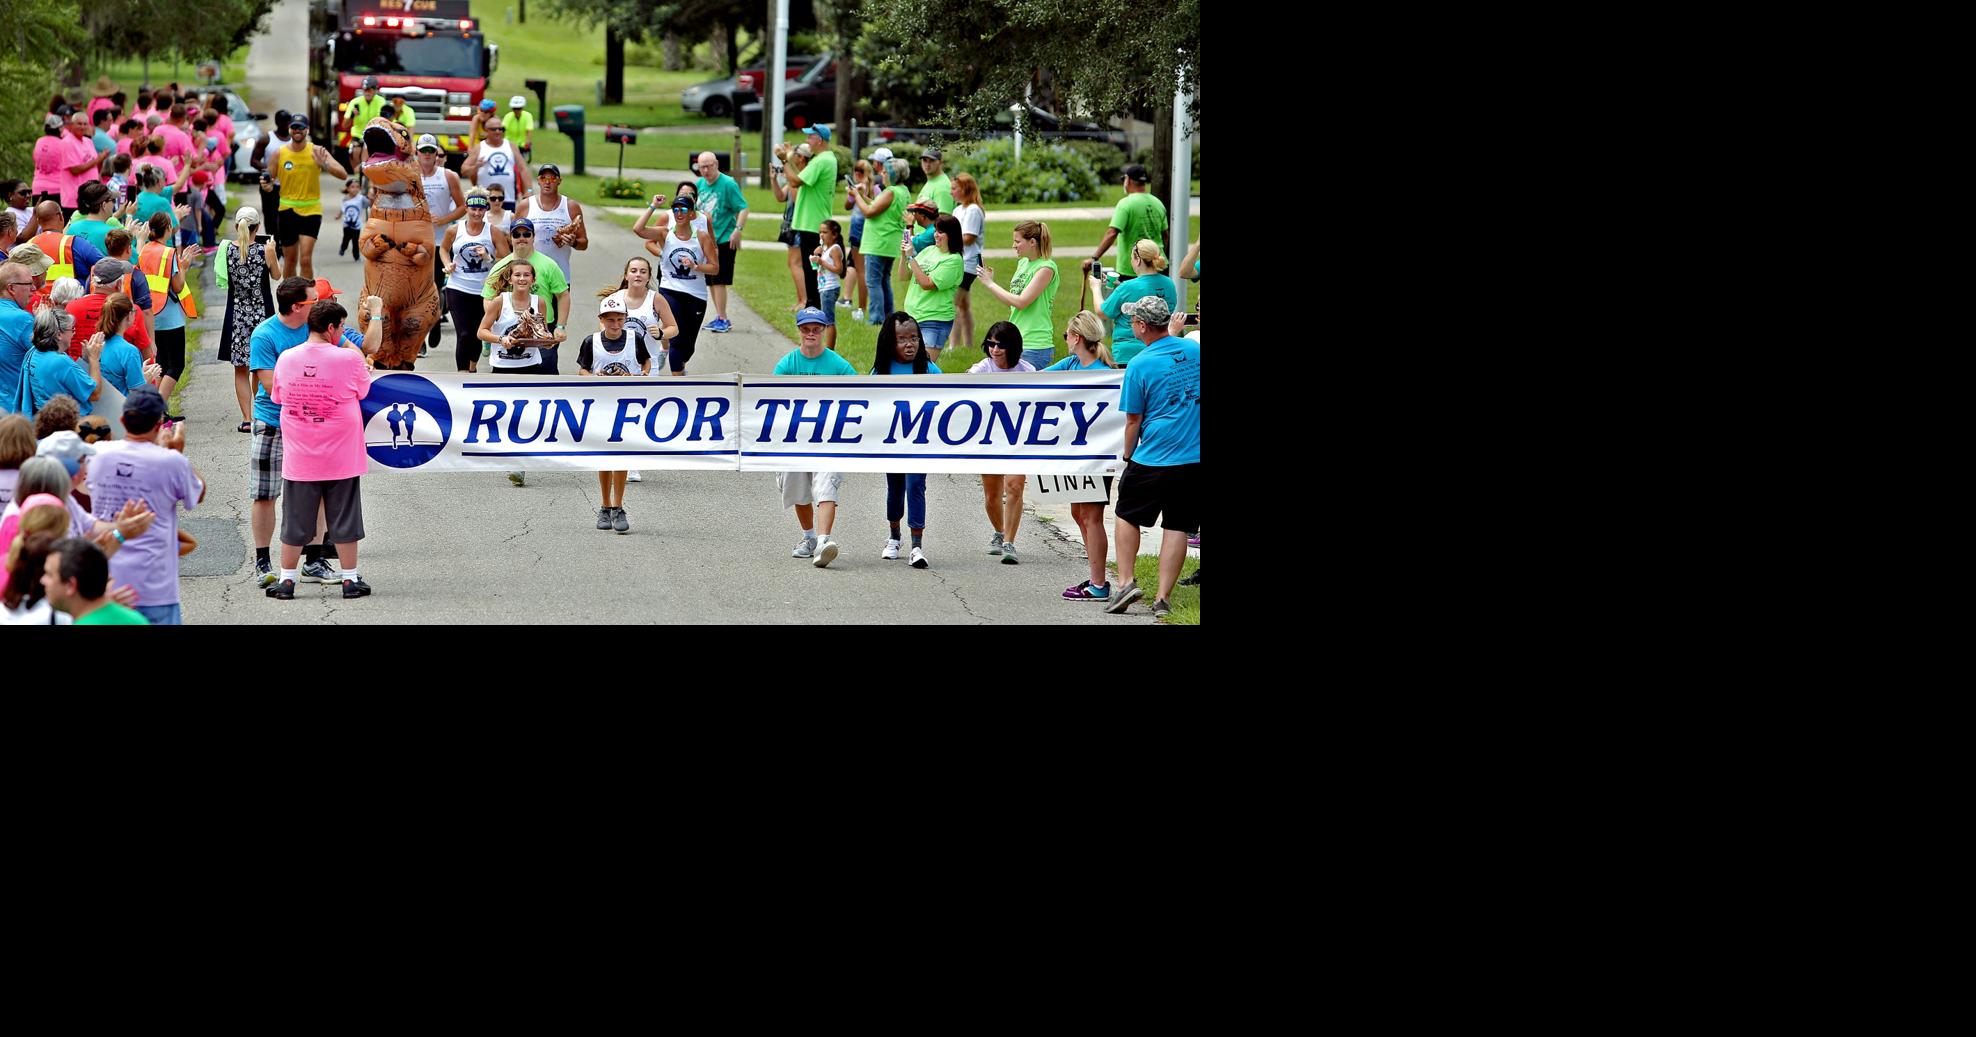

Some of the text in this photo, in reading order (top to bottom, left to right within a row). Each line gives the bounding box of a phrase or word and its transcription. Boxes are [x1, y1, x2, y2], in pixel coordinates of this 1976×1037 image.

[464, 397, 1110, 446] RUN FOR THE MONEY
